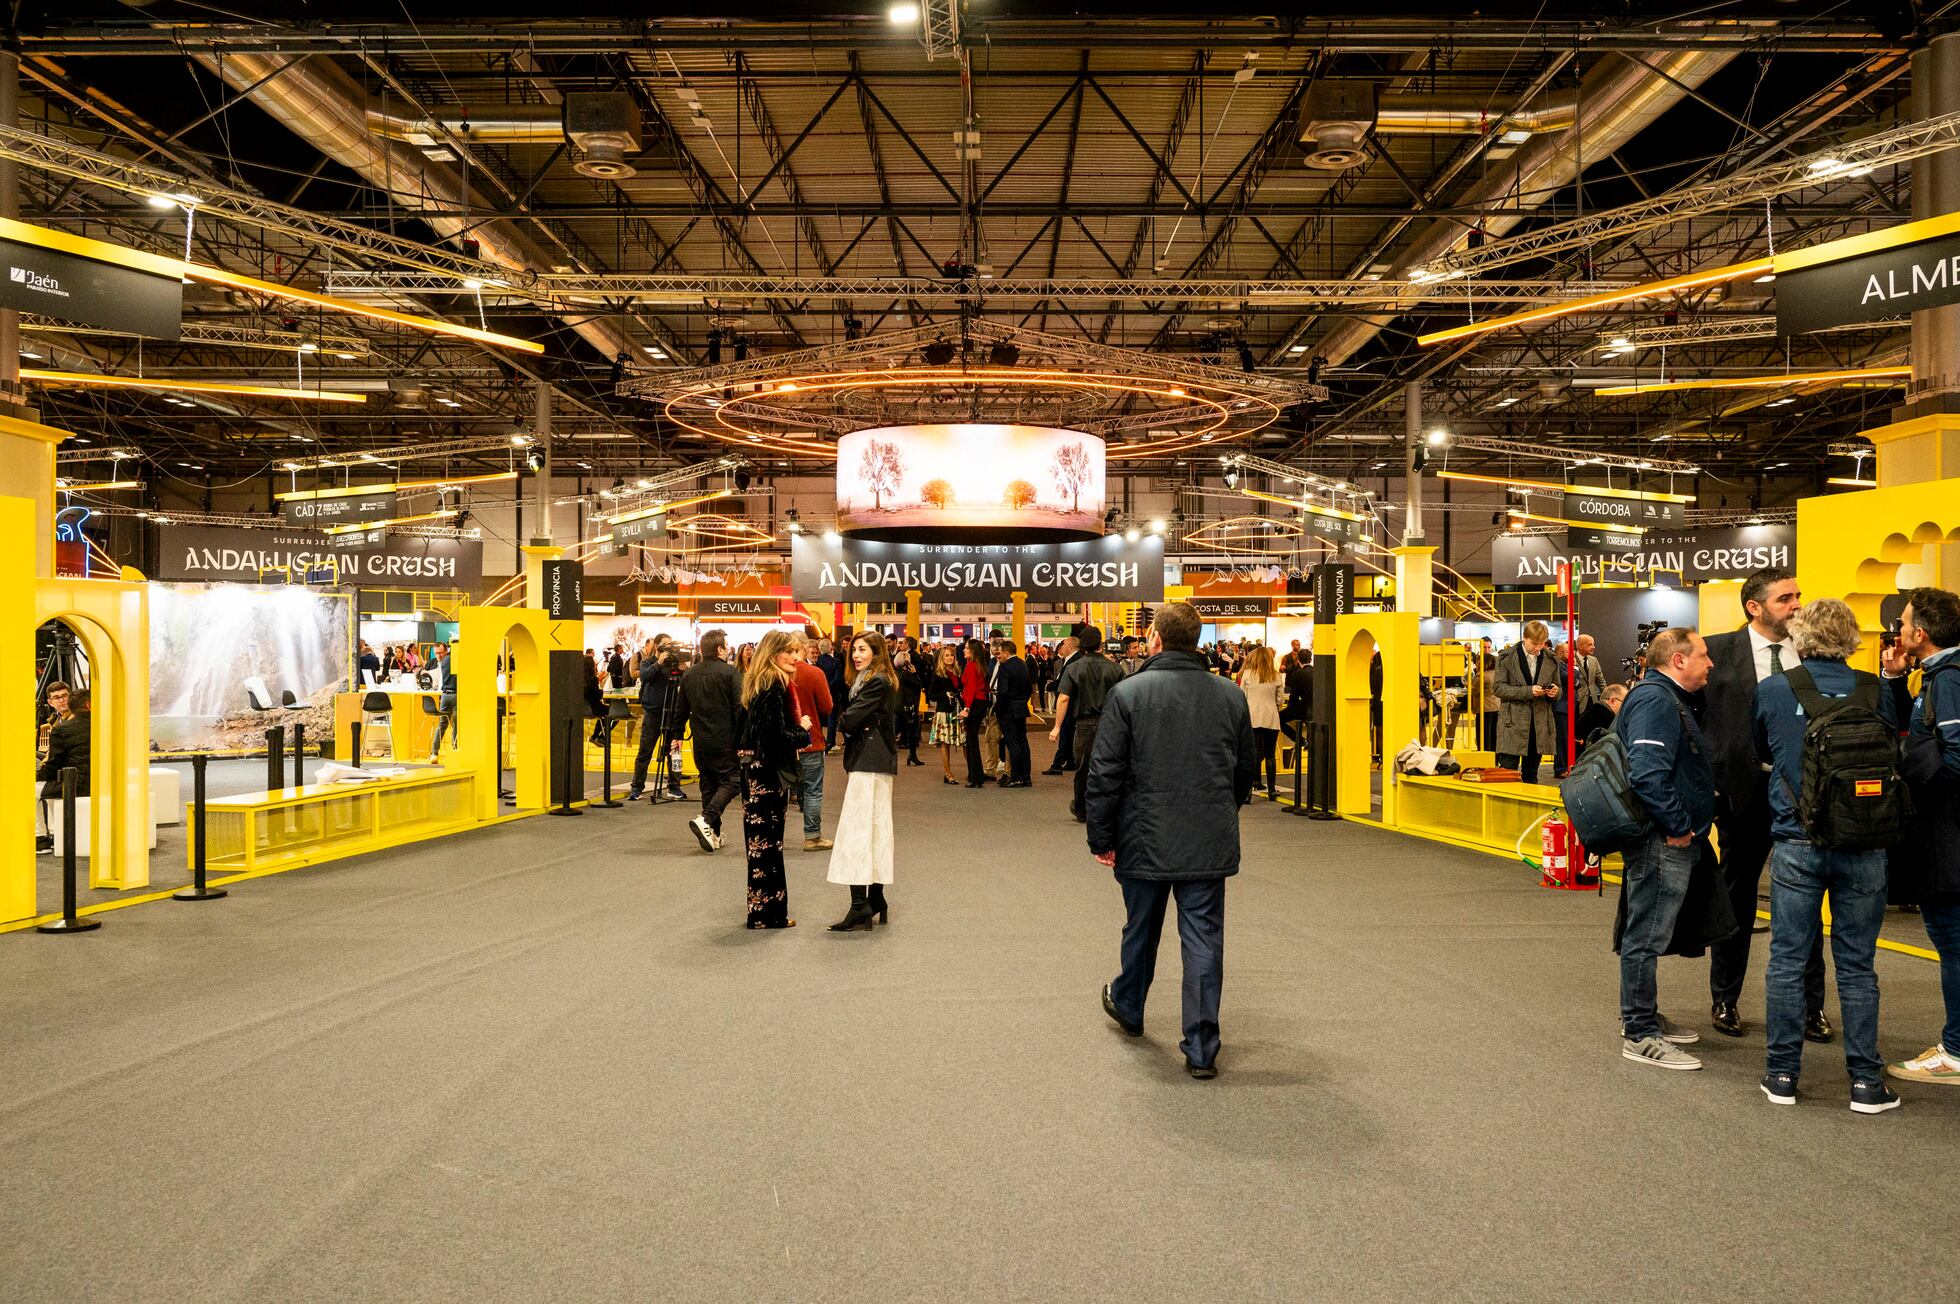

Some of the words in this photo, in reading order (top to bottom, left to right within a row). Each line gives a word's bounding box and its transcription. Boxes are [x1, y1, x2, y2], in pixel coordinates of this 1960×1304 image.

[26, 270, 59, 290] Jaén
[1861, 255, 1960, 305] ALME
[295, 502, 323, 517] CÁDZ
[1579, 499, 1631, 517] CÓRDOBA
[621, 523, 641, 538] SEVILLA
[1606, 535, 1641, 548] TORREMOLINOS
[366, 553, 456, 578] CRUSH
[1693, 545, 1789, 570] CRUSH
[818, 561, 1021, 591] ANDALUSIAN
[1031, 561, 1139, 588] CRUSH
[552, 565, 561, 616] PROVINCIA
[714, 603, 761, 613] SEVILLA
[1194, 604, 1221, 613] COSTA
[1225, 604, 1241, 613] DEL
[1244, 604, 1262, 613] SOL
